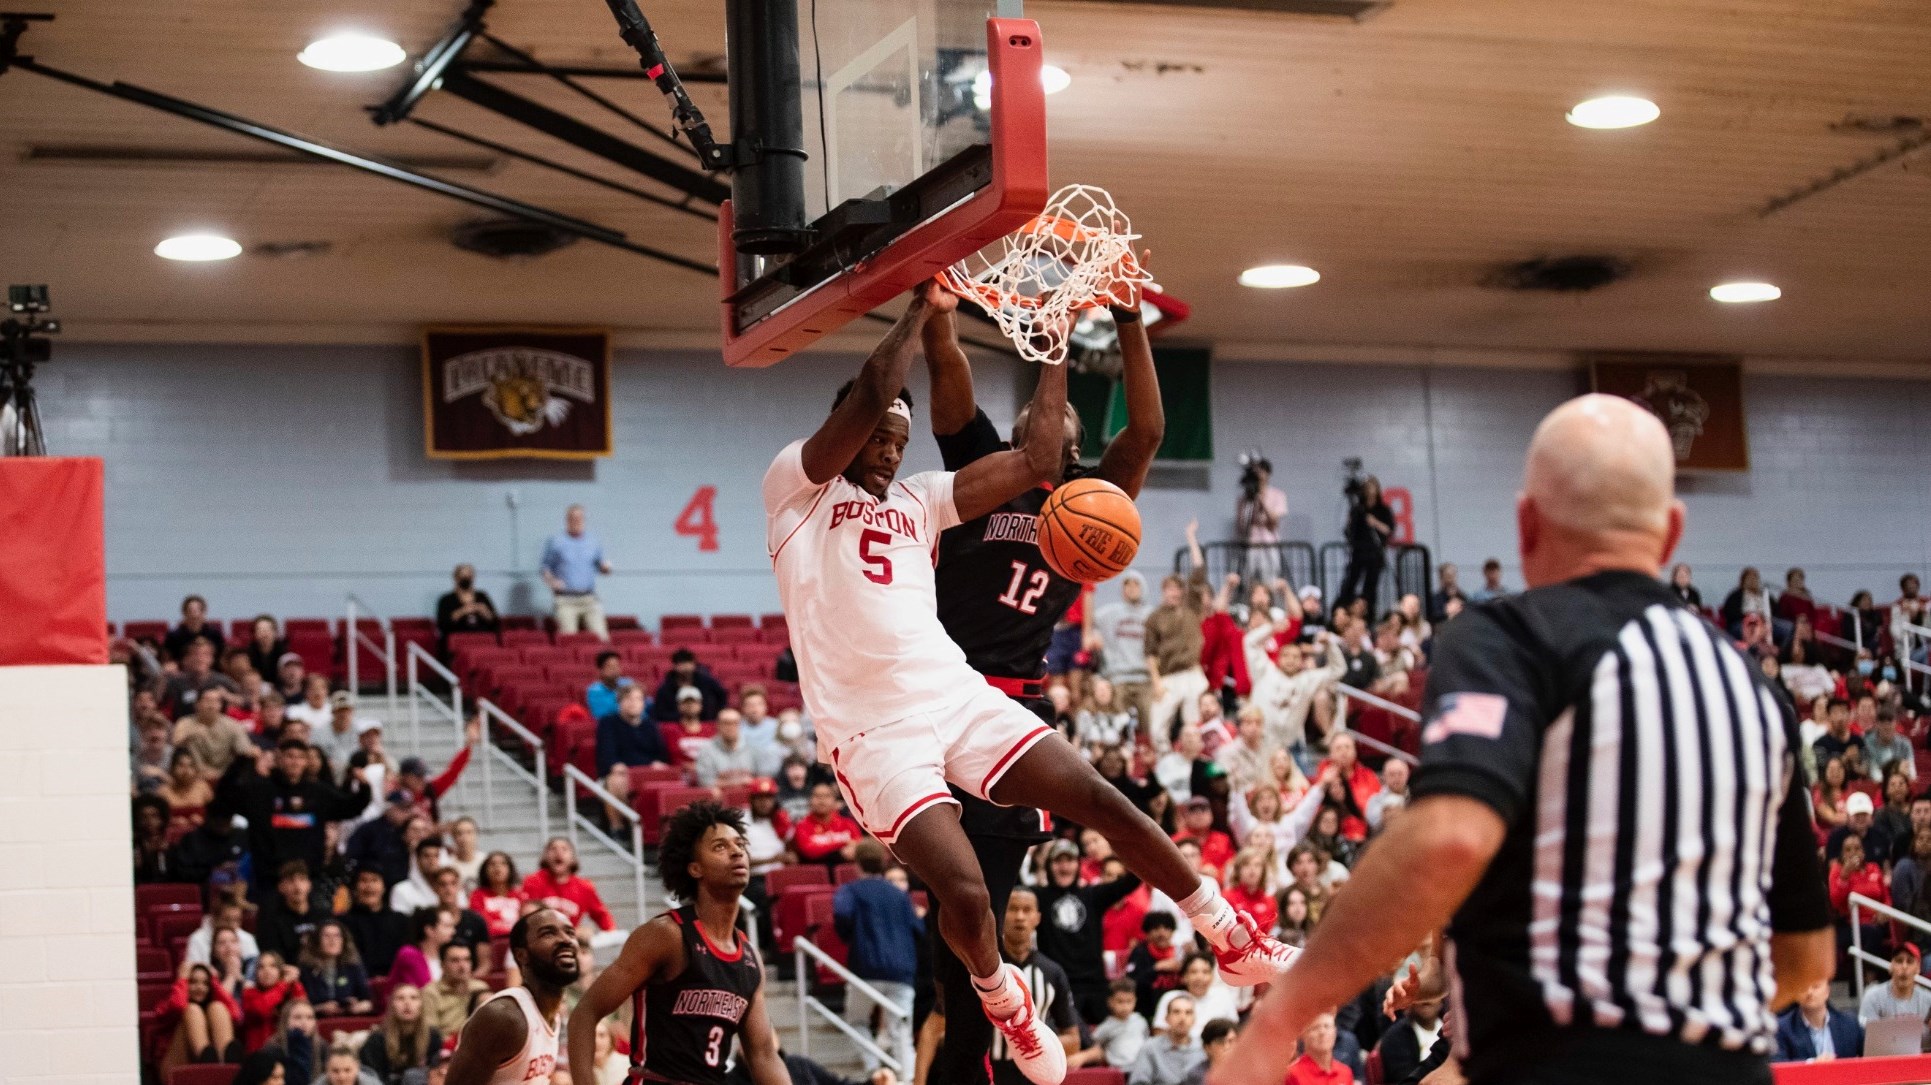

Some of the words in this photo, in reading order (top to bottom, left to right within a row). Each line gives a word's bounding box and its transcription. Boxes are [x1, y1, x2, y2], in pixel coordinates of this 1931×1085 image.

[674, 485, 719, 552] 4
[829, 501, 919, 542] BOSTON
[1079, 523, 1113, 555] THE
[859, 529, 893, 585] 5
[999, 560, 1050, 615] 12
[705, 1026, 724, 1067] 3
